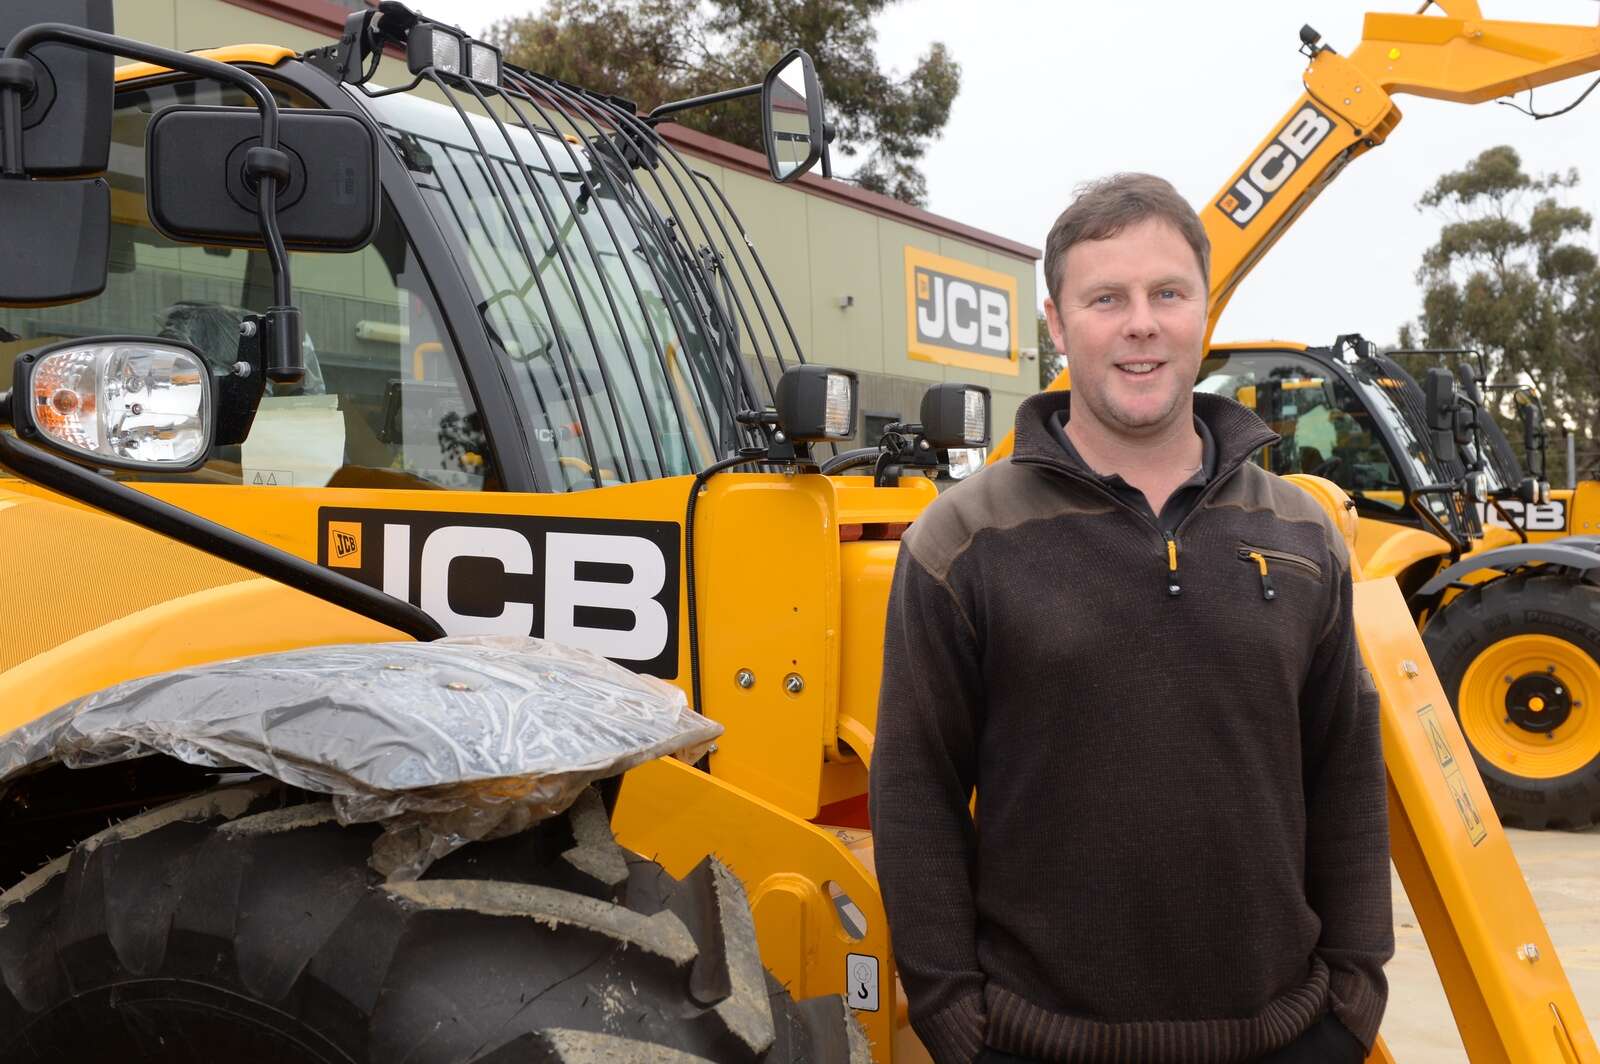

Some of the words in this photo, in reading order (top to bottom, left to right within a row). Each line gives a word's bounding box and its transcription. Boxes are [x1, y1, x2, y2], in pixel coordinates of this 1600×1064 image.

[1232, 108, 1330, 223] JCB
[918, 276, 1010, 351] JCB
[337, 533, 356, 555] JCB
